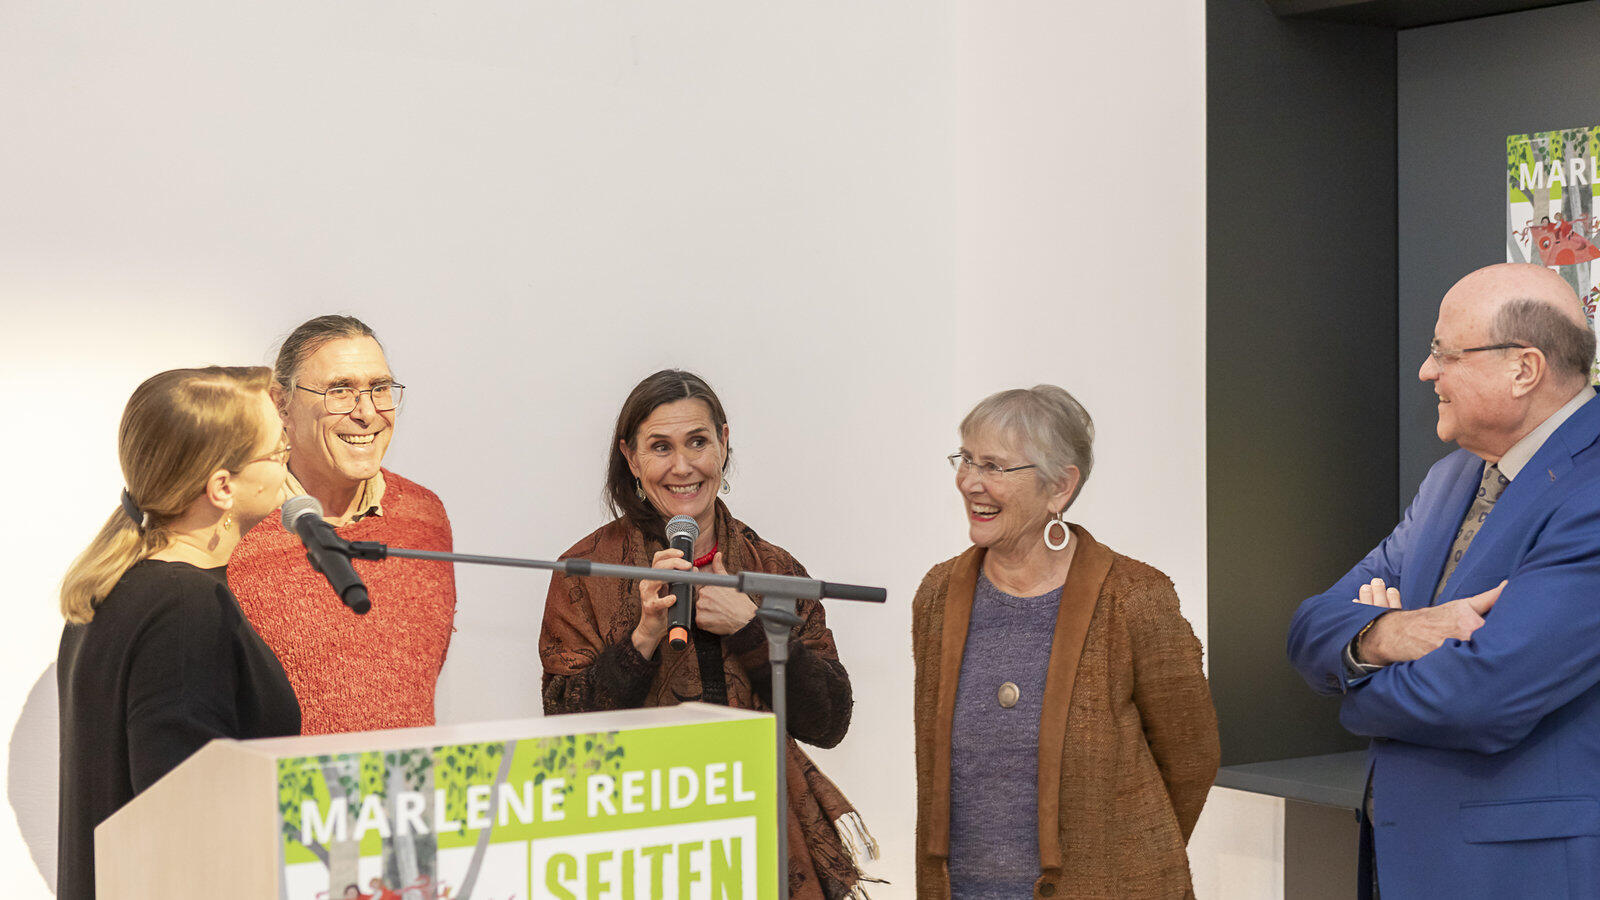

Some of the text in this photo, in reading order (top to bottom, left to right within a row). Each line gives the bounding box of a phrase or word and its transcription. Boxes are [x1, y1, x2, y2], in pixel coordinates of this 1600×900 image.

[1518, 155, 1600, 191] MARL
[300, 761, 756, 846] MARLENE REIDEL
